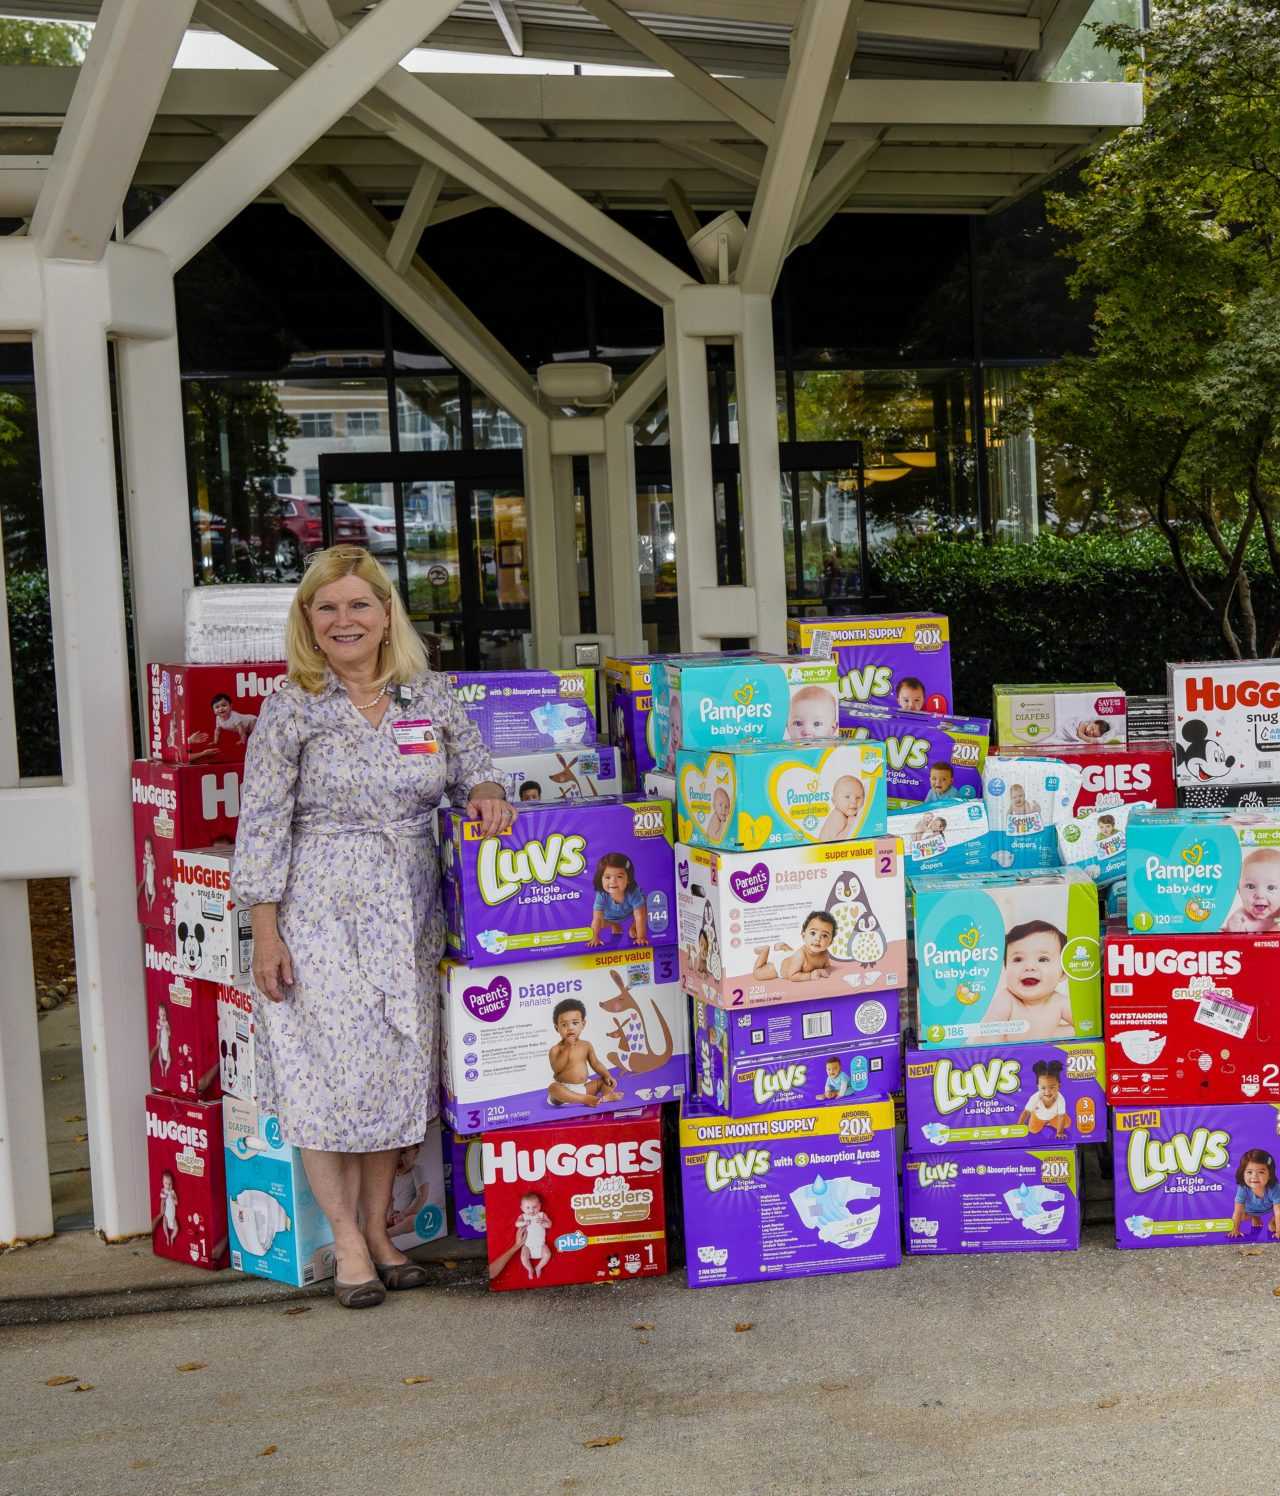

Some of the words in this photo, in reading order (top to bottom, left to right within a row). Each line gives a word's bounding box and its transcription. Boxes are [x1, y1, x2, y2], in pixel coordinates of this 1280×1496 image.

[868, 627, 904, 640] SUPPLY
[559, 679, 584, 692] 20X
[152, 663, 162, 759] HUGGIES
[700, 697, 772, 723] Pampers
[1015, 713, 1050, 721] DIAPERS
[1246, 712, 1279, 724] snug
[132, 778, 177, 810] HUGGIES
[786, 789, 830, 805] Pampers
[849, 847, 873, 858] value
[173, 858, 230, 891] HUGGIES
[477, 834, 586, 906] Luvs
[920, 861, 943, 870] diapers
[1146, 856, 1223, 881] Pampers
[530, 885, 560, 896] Triple
[595, 954, 622, 966] super
[924, 942, 999, 967] Pampers
[1108, 944, 1242, 976] HUGGIES
[519, 979, 582, 999] Diapers
[217, 984, 252, 1013] HUGGIES
[1110, 1012, 1168, 1020] OUTSTANDING
[909, 1067, 934, 1078] NEW!
[1067, 1056, 1096, 1072] 20X
[753, 1063, 807, 1105] Luvs
[852, 1072, 866, 1082] 108
[1241, 1074, 1260, 1083] 148
[1262, 1064, 1280, 1087] 2
[933, 1059, 1022, 1115] Luvs
[697, 1124, 723, 1140] ONE
[725, 1121, 768, 1138] MONTH
[771, 1118, 817, 1135] SUPPLY
[839, 1118, 872, 1136] 20X
[1122, 1113, 1158, 1128] NEW!
[146, 1111, 208, 1149] HUGGIES
[271, 1122, 280, 1140] 2
[482, 1139, 662, 1185] HUGGIES
[1128, 1127, 1231, 1193] Luvs
[705, 1149, 771, 1192] Luvs
[774, 1157, 793, 1167] with
[810, 1153, 856, 1165] Absorption
[857, 1149, 881, 1161] Areas
[918, 1162, 958, 1187] Luvs
[1042, 1162, 1069, 1177] 20X
[1164, 1183, 1225, 1194] Leakguards
[1176, 1176, 1204, 1187] Triple
[573, 1190, 651, 1208] snugglers
[424, 1212, 433, 1230] 2
